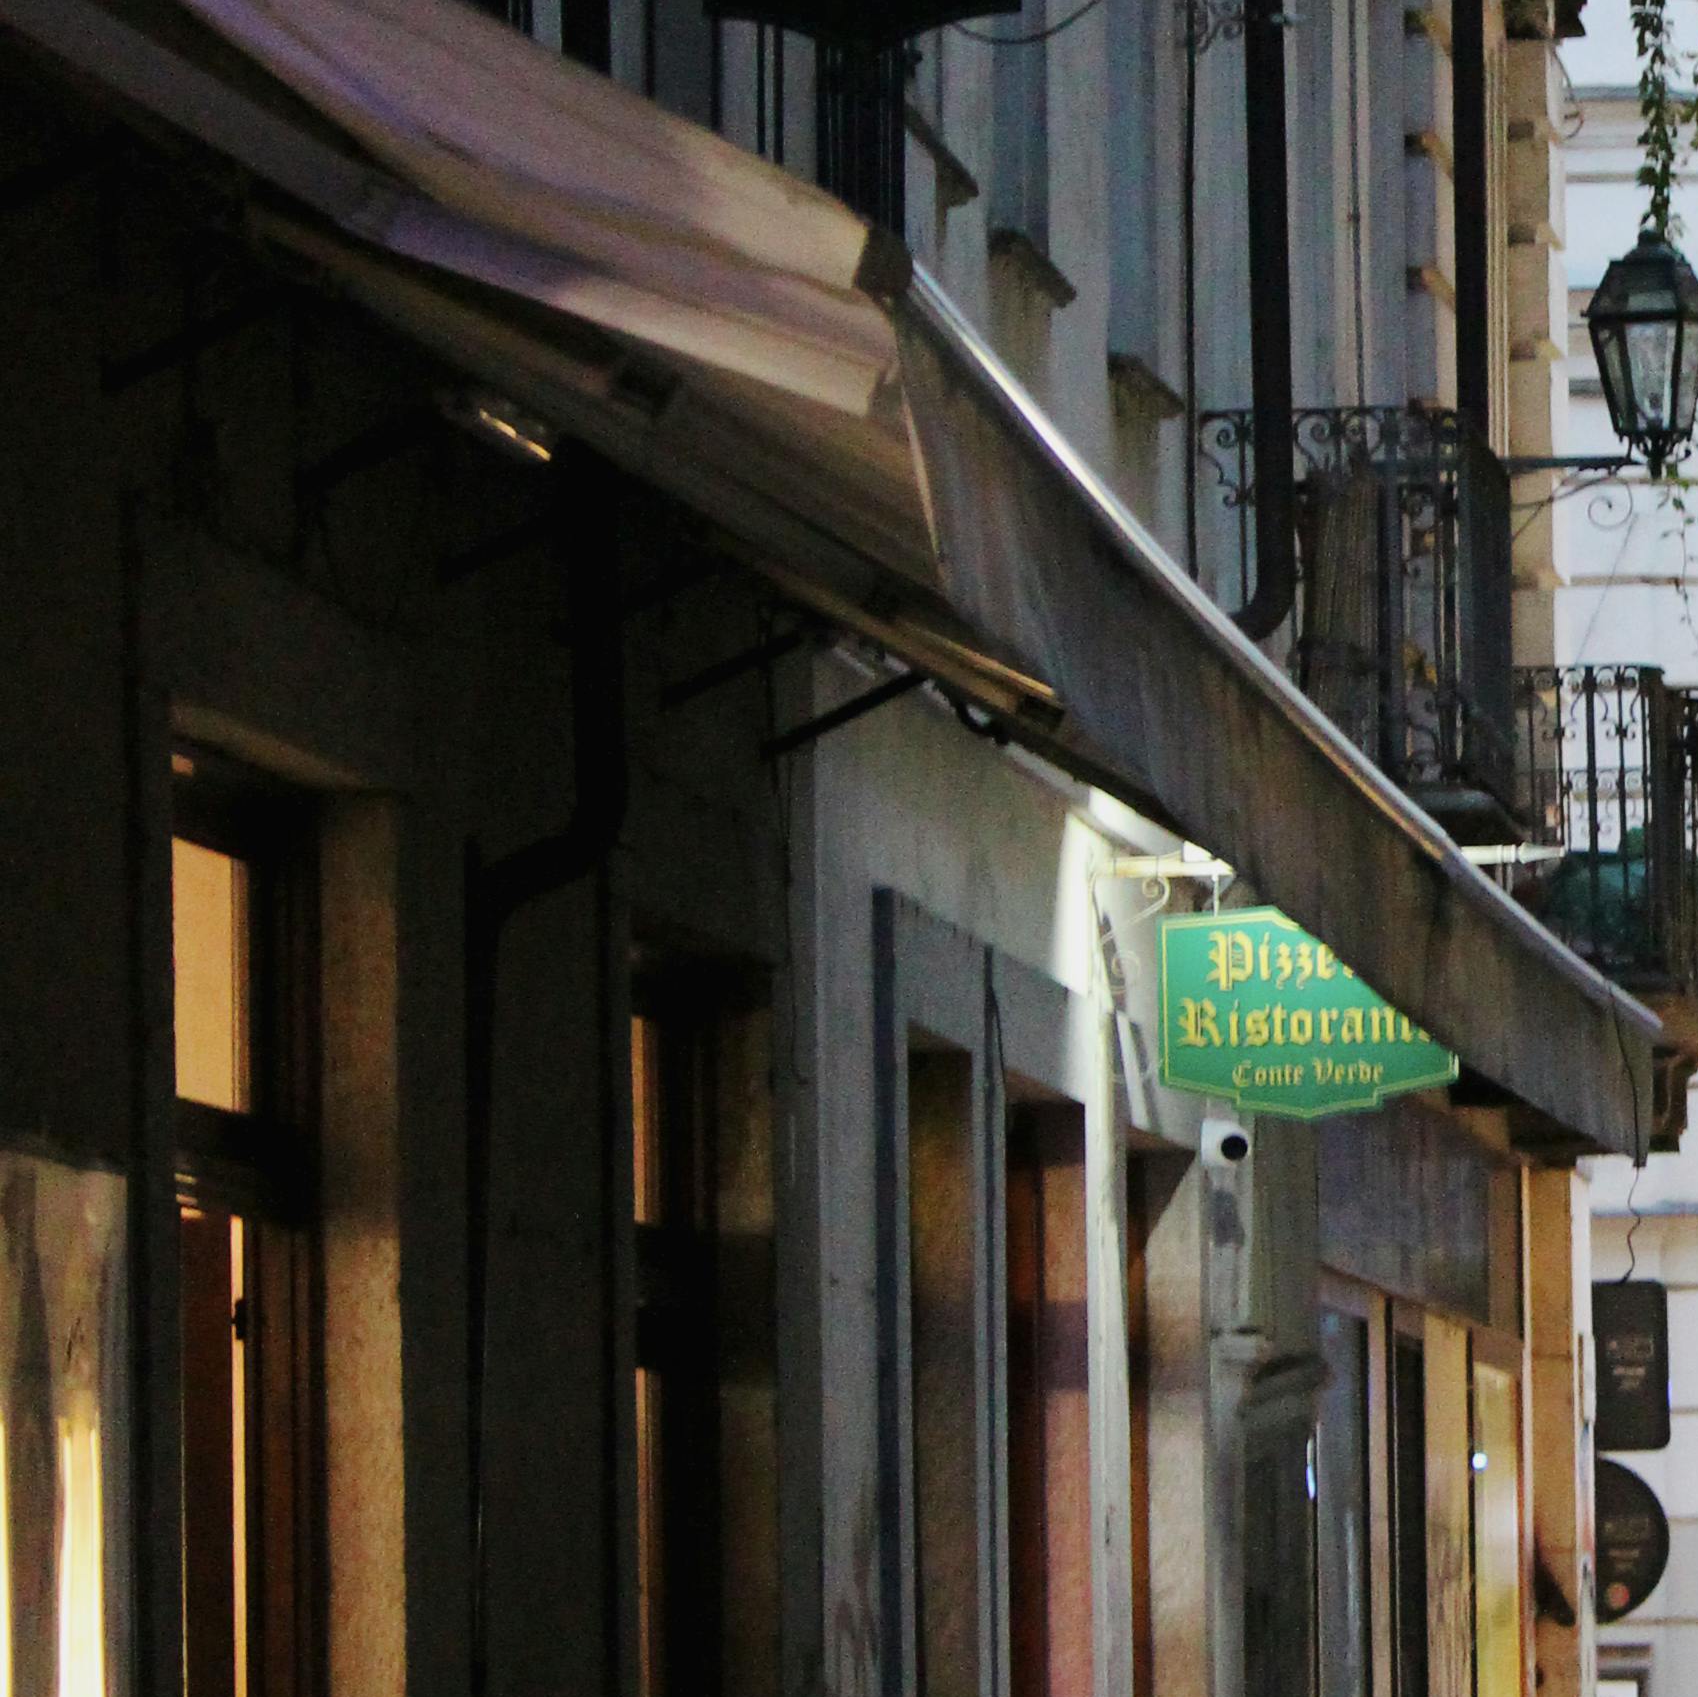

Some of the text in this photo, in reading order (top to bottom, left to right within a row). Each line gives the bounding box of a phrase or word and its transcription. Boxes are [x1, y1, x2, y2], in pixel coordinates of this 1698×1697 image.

[1206, 929, 1355, 991] Pizze
[1232, 1056, 1385, 1088] Conte Verde
